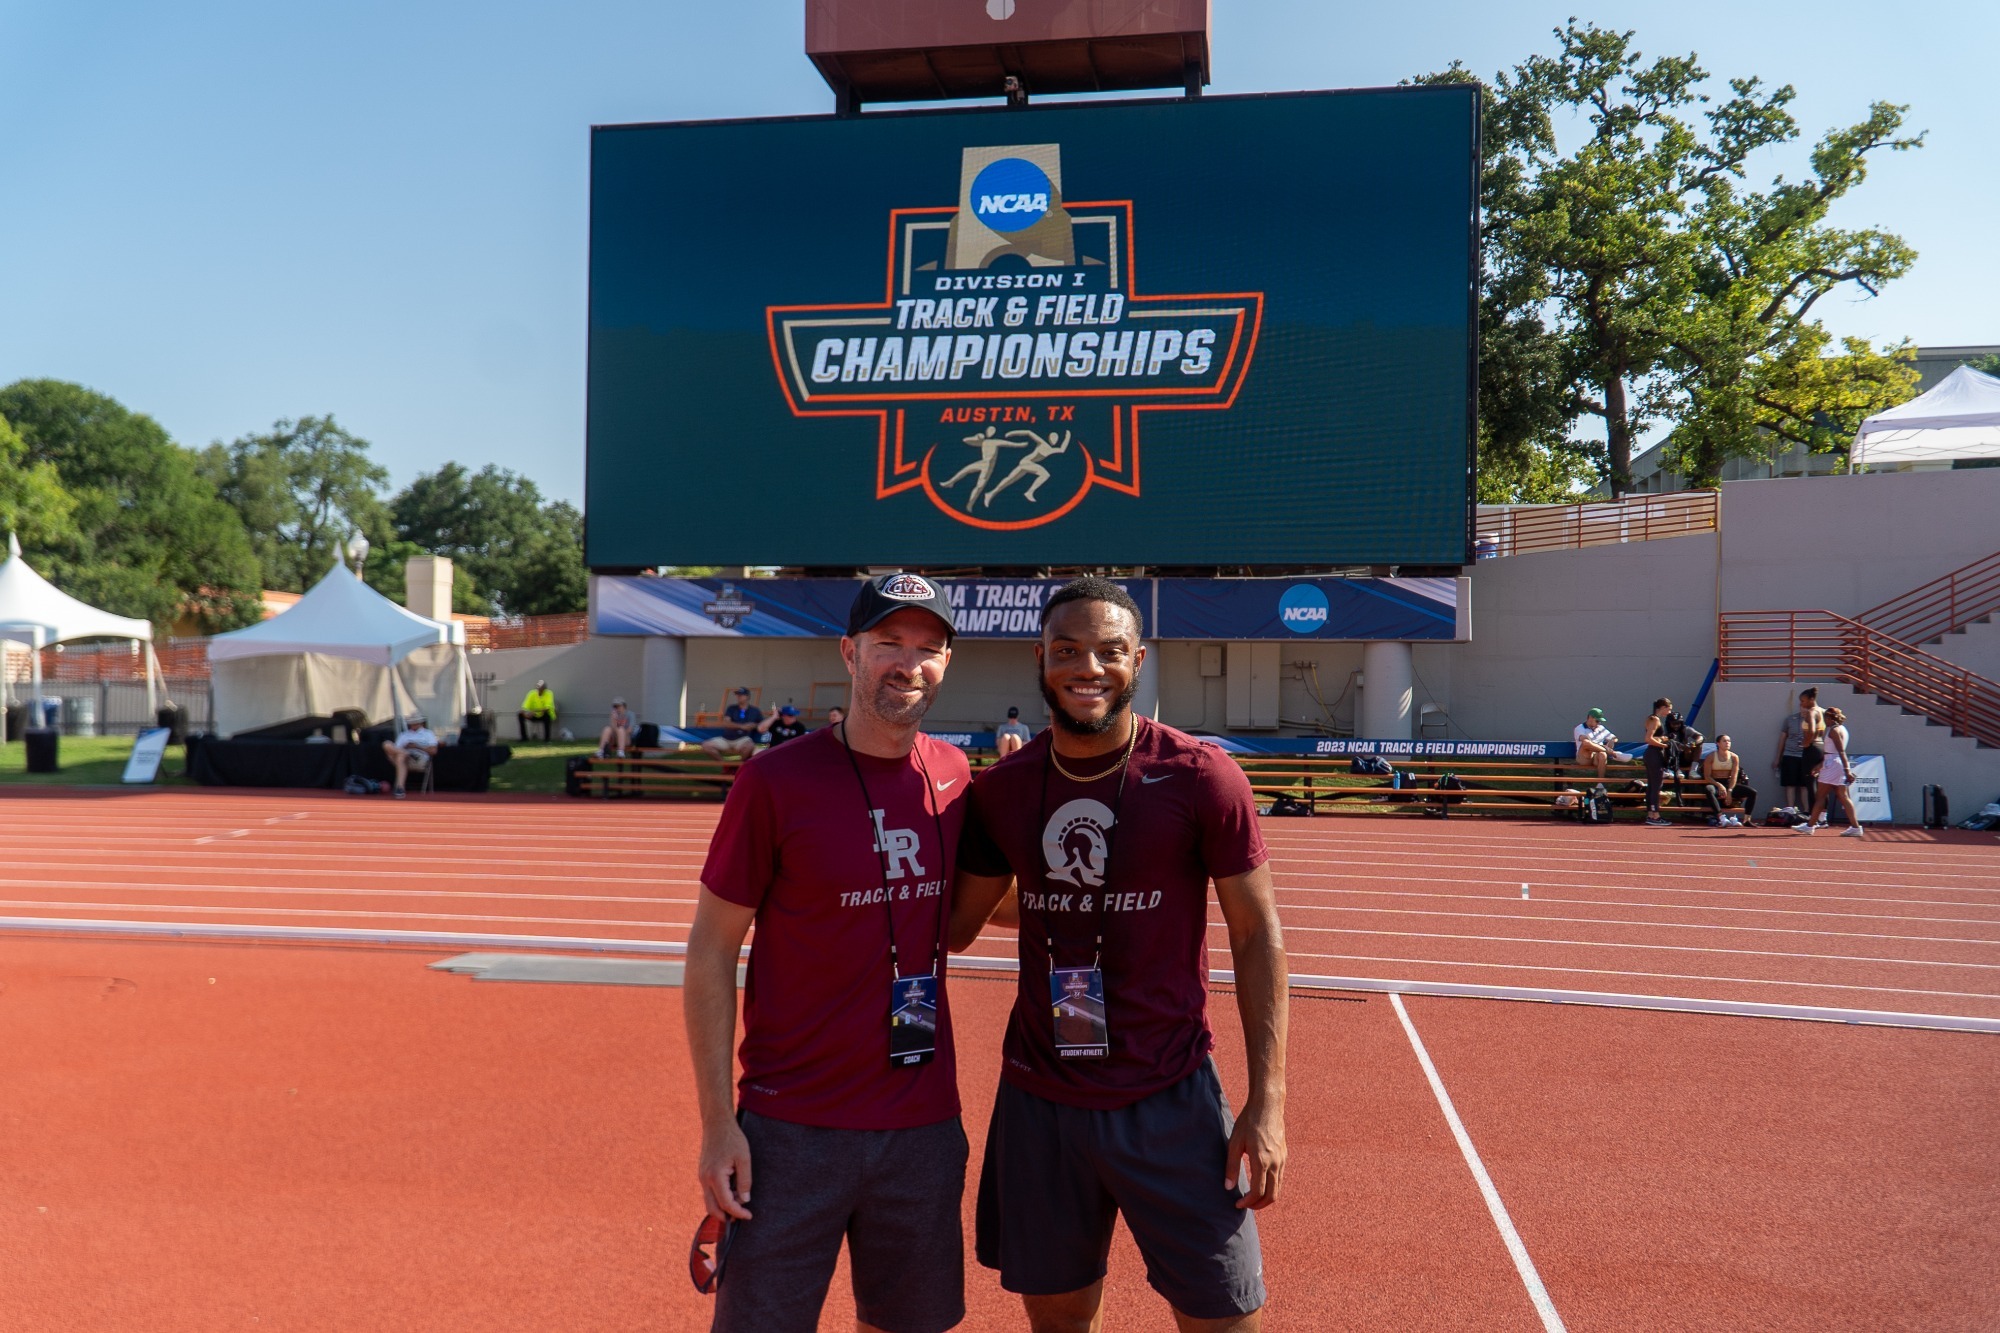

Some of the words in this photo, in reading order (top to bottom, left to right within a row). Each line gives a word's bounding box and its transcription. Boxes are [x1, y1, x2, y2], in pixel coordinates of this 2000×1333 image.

[978, 194, 1049, 214] NCAA
[935, 274, 1062, 291] DIVISION
[1073, 272, 1085, 287] I
[896, 297, 996, 329] TRACK
[1003, 296, 1028, 326] &
[1036, 292, 1124, 325] FIELD
[810, 328, 1217, 383] CHAMPIONSHIPS
[940, 406, 1037, 424] AUSTIN,
[1047, 405, 1075, 421] TX
[975, 584, 1044, 608] TRACK
[1283, 607, 1328, 621] NCAA
[1316, 741, 1345, 752] 2023
[1347, 741, 1375, 753] NCAA
[1379, 742, 1412, 754] TRACK
[1415, 742, 1424, 754] &
[1425, 742, 1454, 754] FIELD
[1456, 743, 1546, 756] CHAMPIONSHIPS
[868, 809, 925, 879] LR
[840, 885, 893, 907] TRACK
[898, 885, 911, 900] &
[1079, 894, 1093, 912] &
[1103, 890, 1162, 912] FIELD
[903, 1055, 921, 1064] COACH
[1060, 1049, 1104, 1057] STUDENT-ATHLETE
